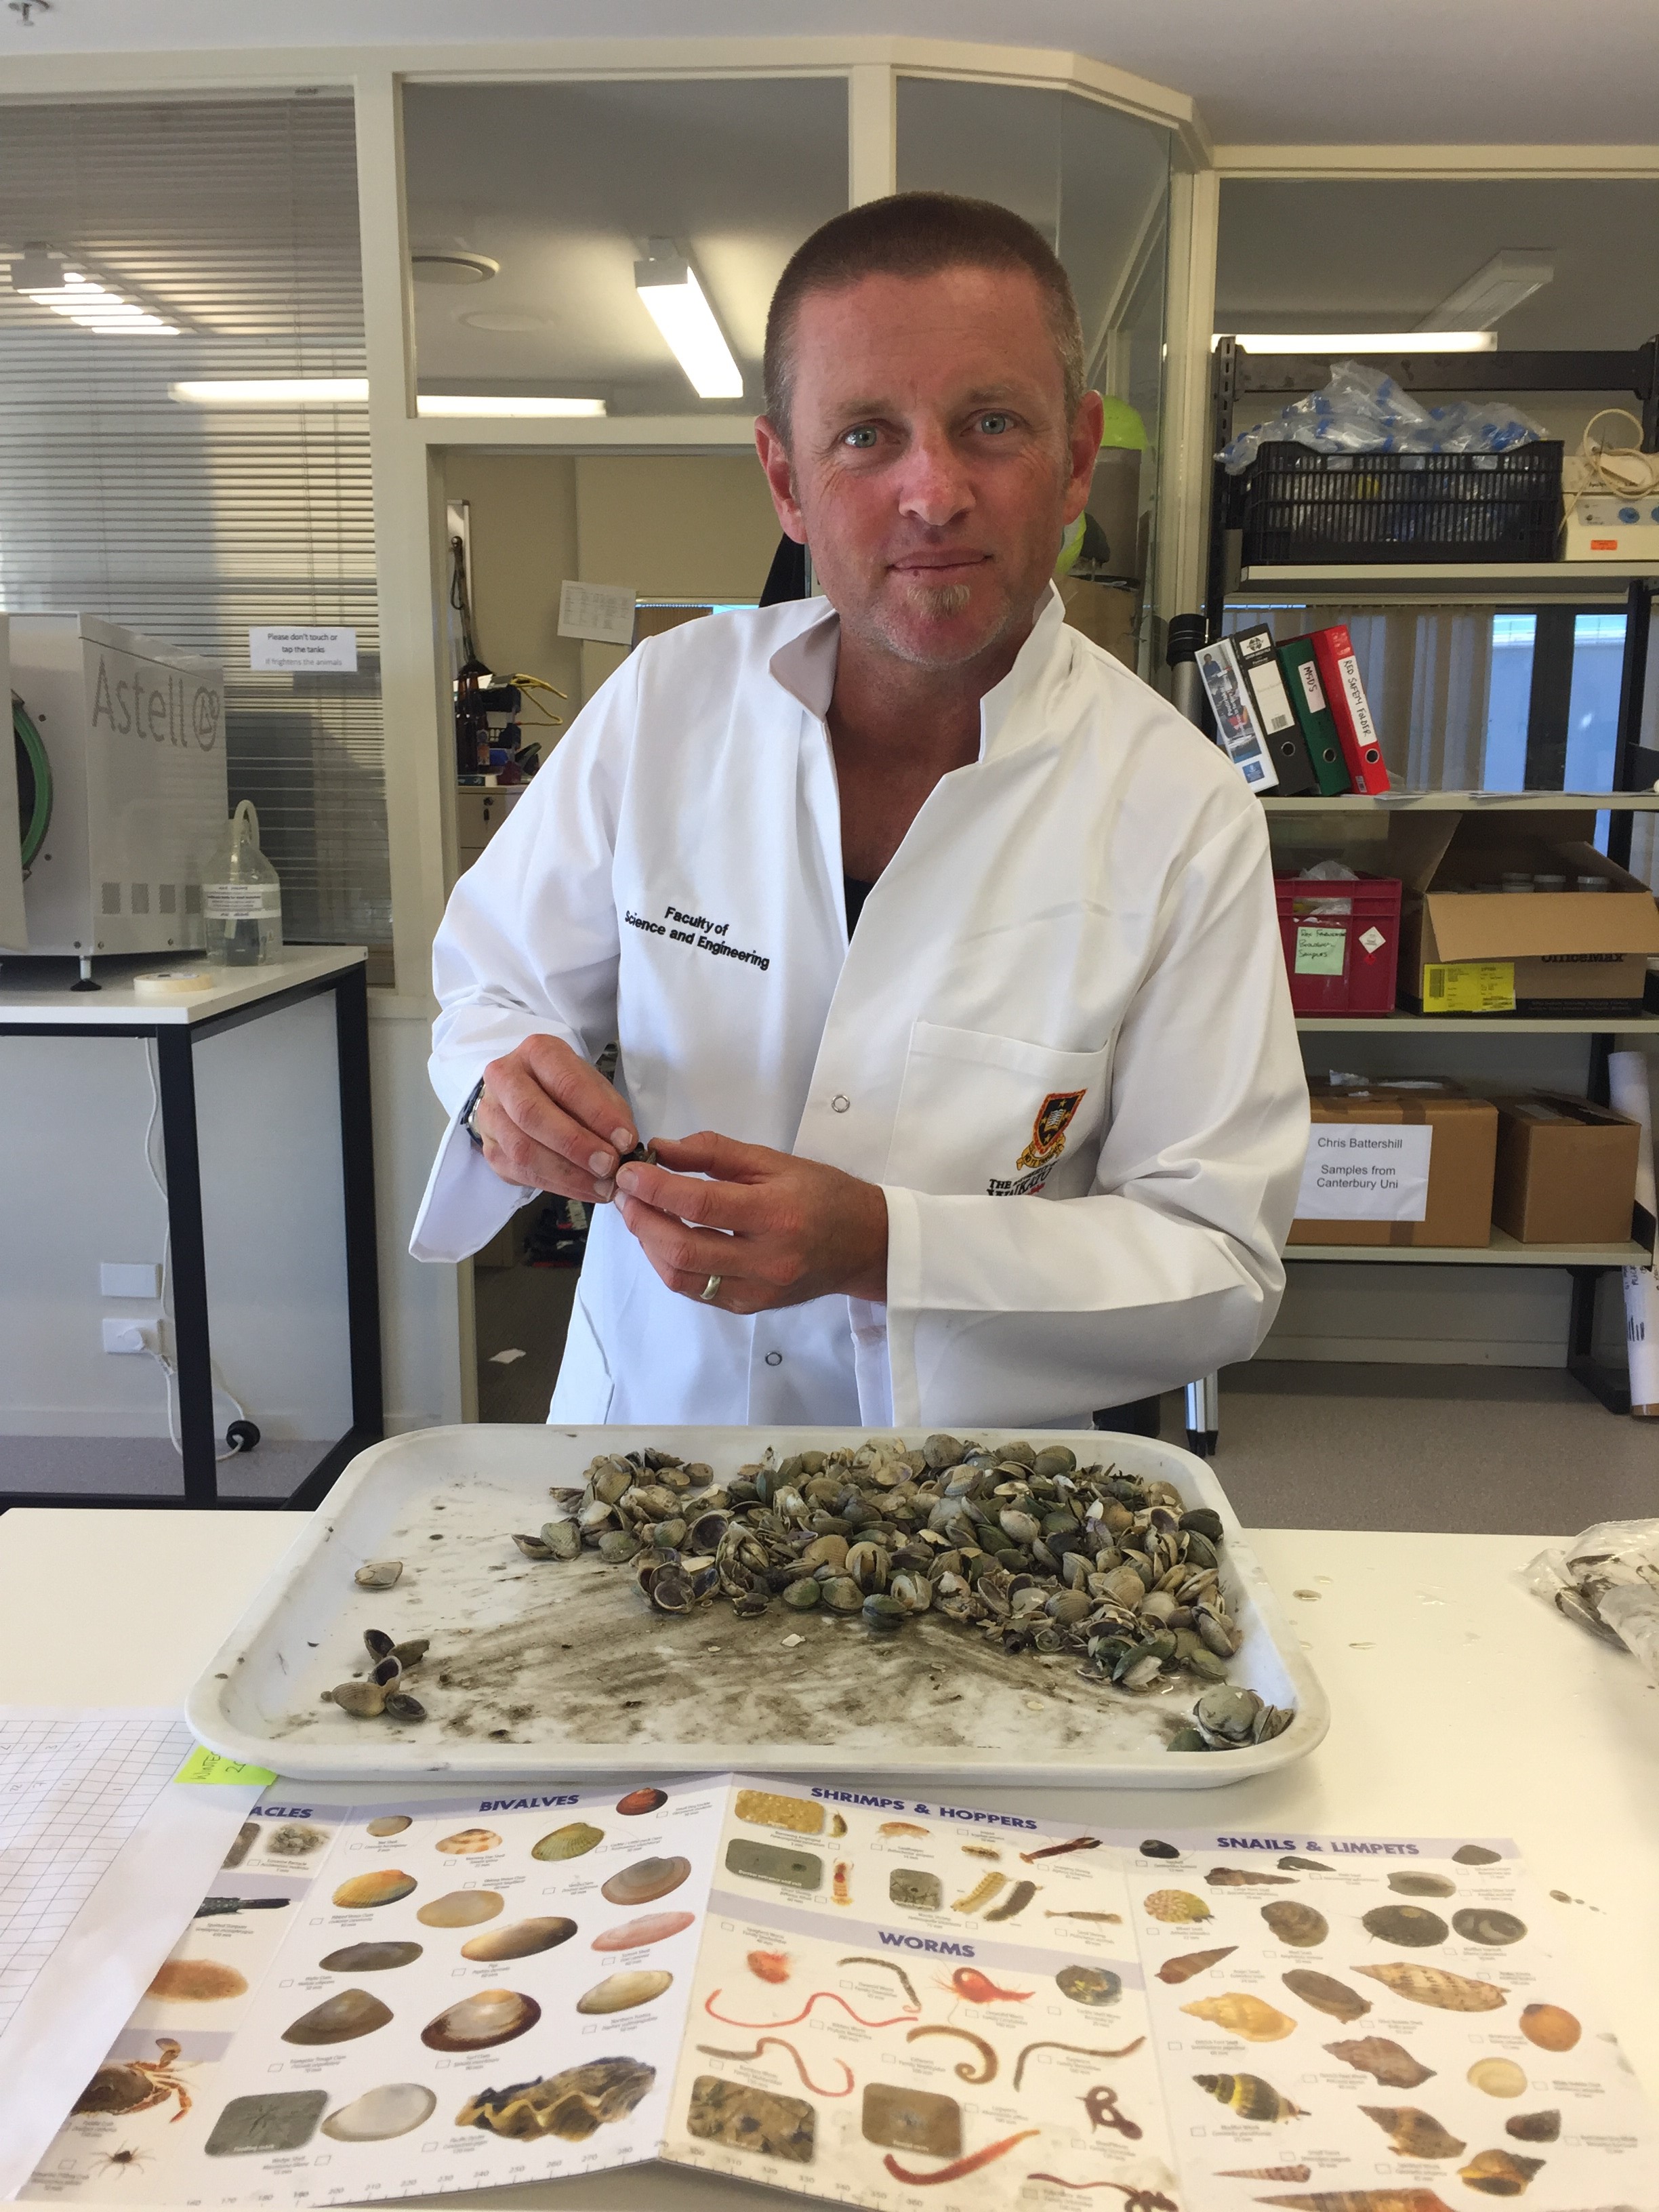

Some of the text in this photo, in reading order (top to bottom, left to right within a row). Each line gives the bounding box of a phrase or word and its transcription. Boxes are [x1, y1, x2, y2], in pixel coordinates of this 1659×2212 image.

[267, 633, 289, 641] Please
[290, 633, 308, 641] don't
[309, 633, 329, 641] touch
[281, 646, 293, 654] tap
[316, 658, 343, 666] animals
[1343, 659, 1354, 675] RED
[1303, 666, 1317, 693] MSDS
[1348, 677, 1363, 705] SAFETY
[91, 655, 188, 747] Astell
[664, 906, 730, 936] Faculty of
[625, 910, 771, 971] Science and Engineering
[1317, 1137, 1403, 1149] Chris Battershill
[1321, 1164, 1396, 1176] Samples from
[989, 1179, 1012, 1189] THE
[1317, 1178, 1399, 1190] Canterbury Uni
[190, 1751, 221, 1780] WINTE
[250, 1805, 314, 1819] ACLES
[478, 1794, 580, 1813] BIVALVES
[811, 1786, 1038, 1830] SHRIMPS & HOPPERS
[1216, 1837, 1420, 1856] SNAILS & LIMPETS
[877, 1931, 976, 1959] WORMS
[328, 2186, 345, 2195] 200
[364, 2182, 382, 2191] 210
[400, 2178, 417, 2188] 220
[437, 2174, 455, 2183] 230
[508, 2165, 525, 2174] 250
[546, 2159, 562, 2169] 260
[581, 2153, 598, 2163] 270
[617, 2146, 634, 2155] 280
